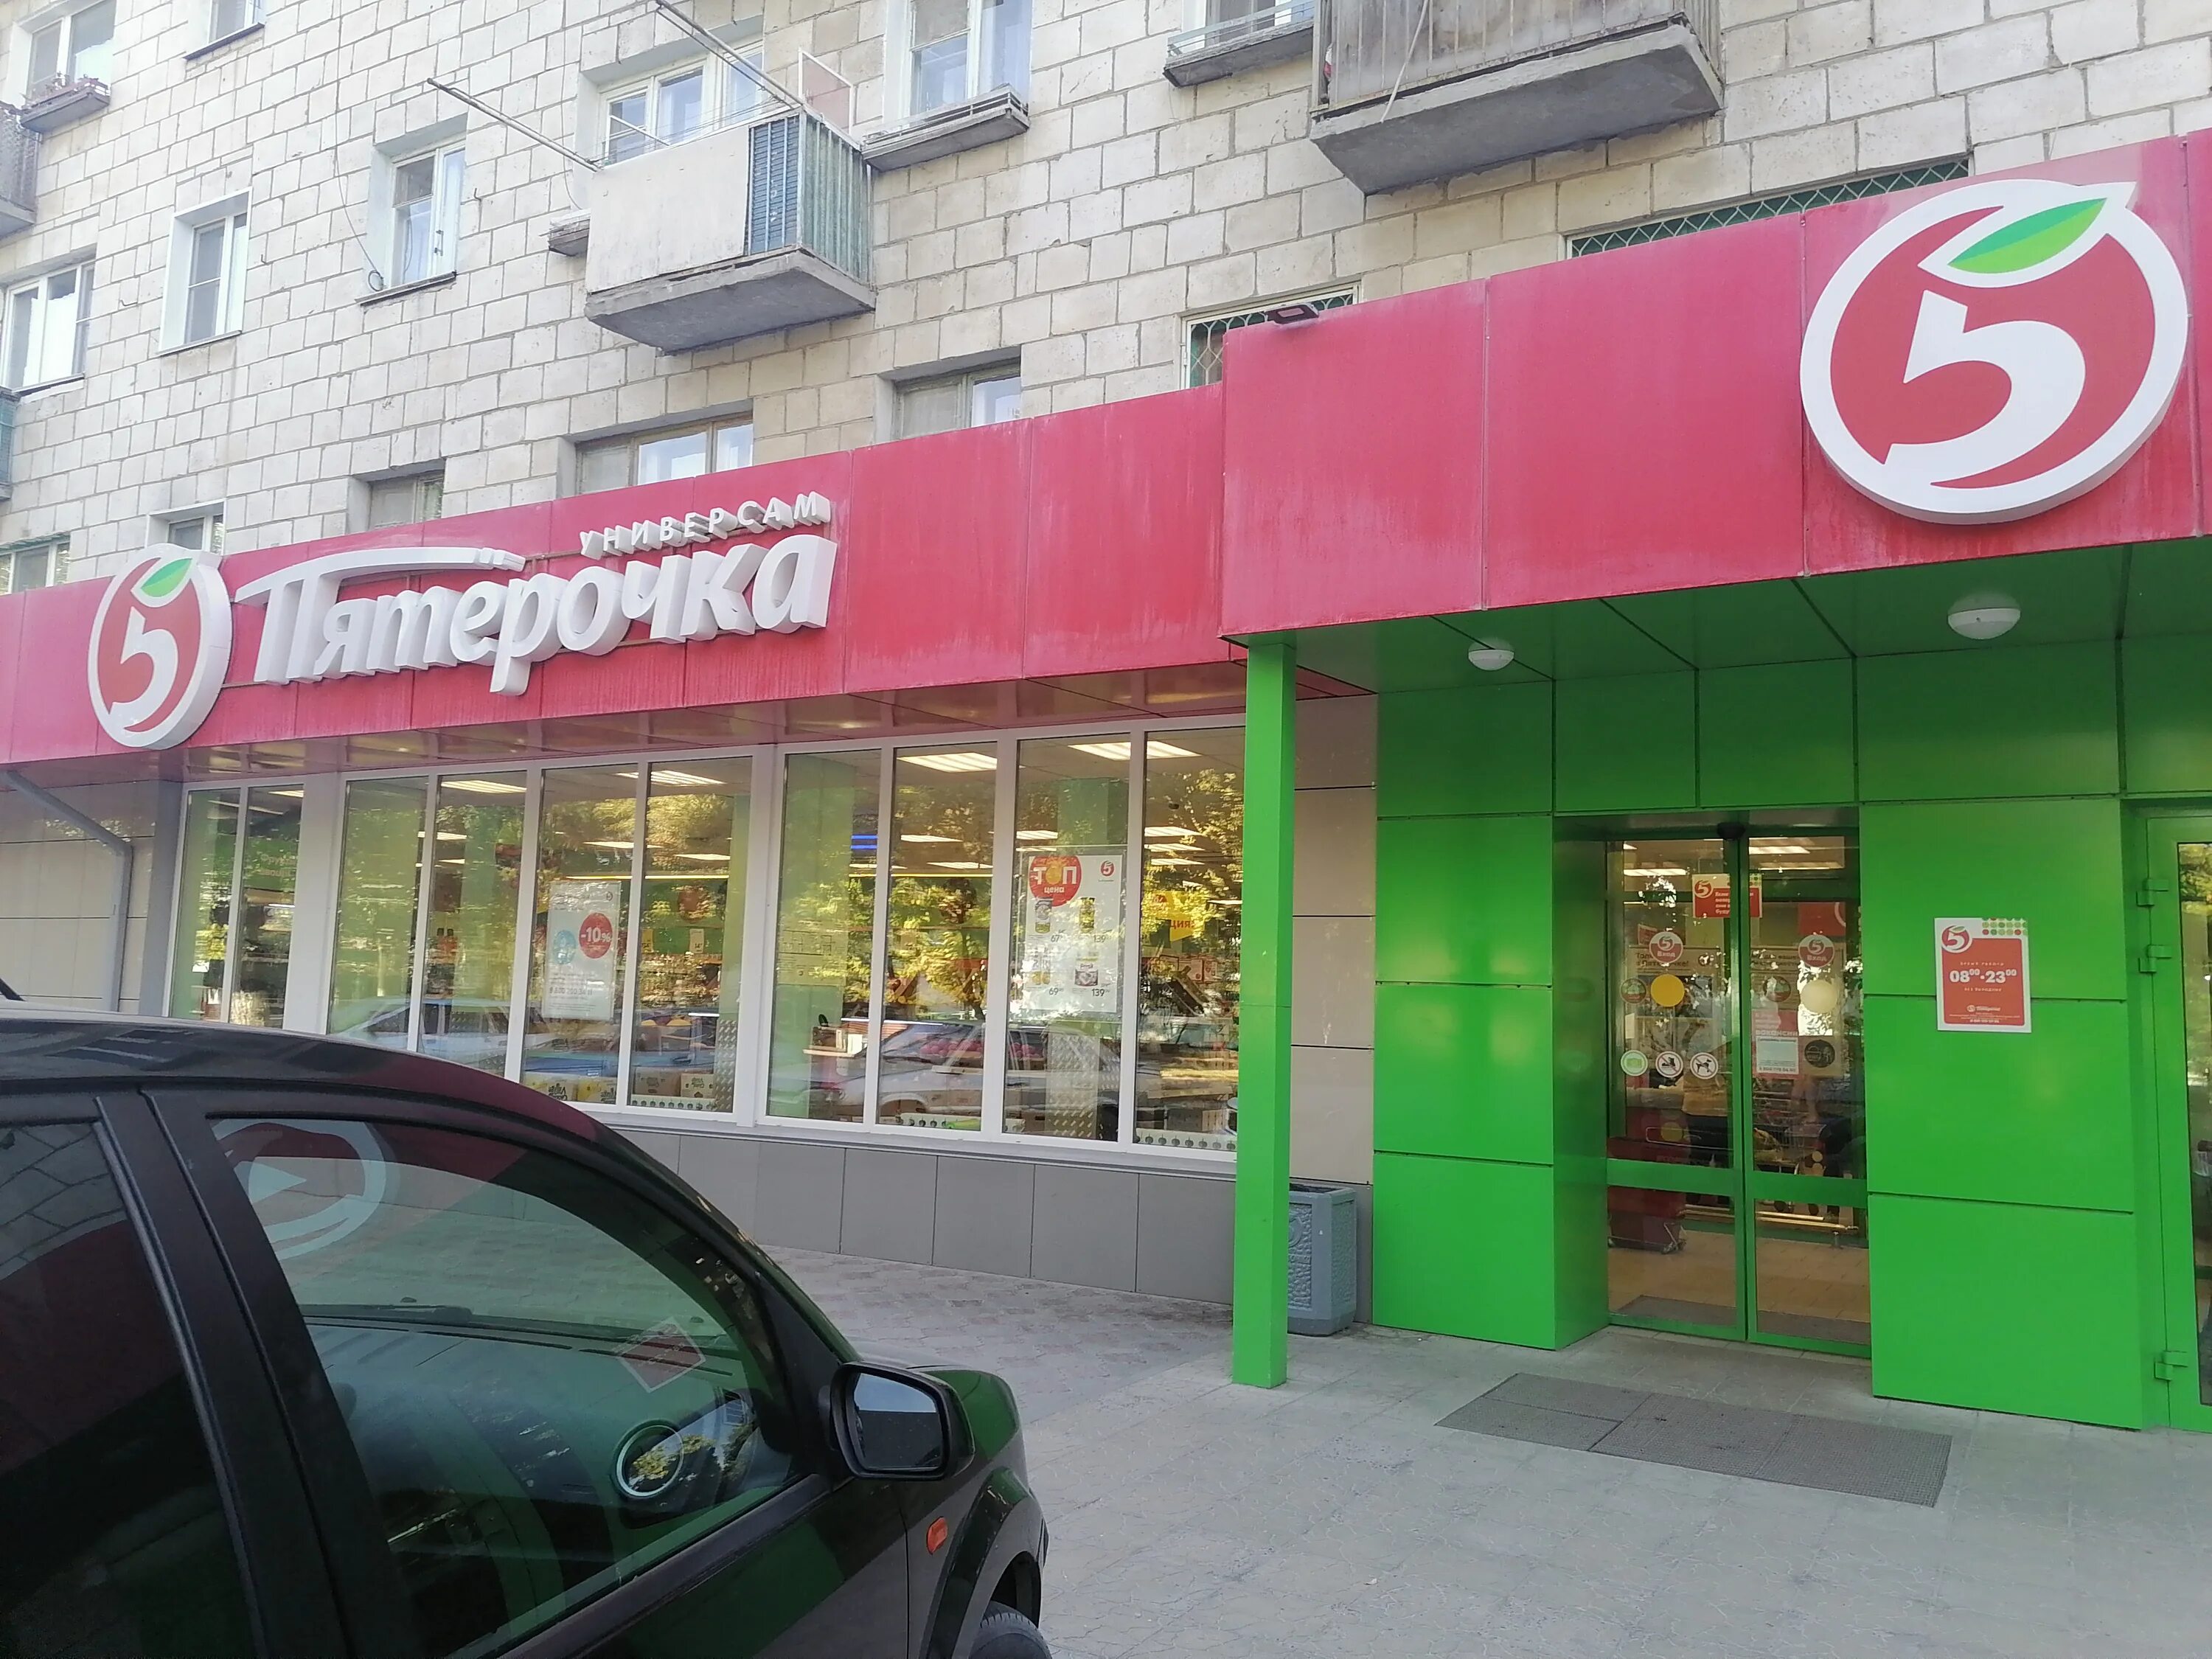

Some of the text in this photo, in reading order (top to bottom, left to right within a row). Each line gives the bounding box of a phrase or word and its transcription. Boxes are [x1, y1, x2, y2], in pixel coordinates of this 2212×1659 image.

[579, 491, 830, 558] УНИВЕРСАМ
[238, 534, 837, 695] Пятерочка
[580, 927, 611, 943] -10%
